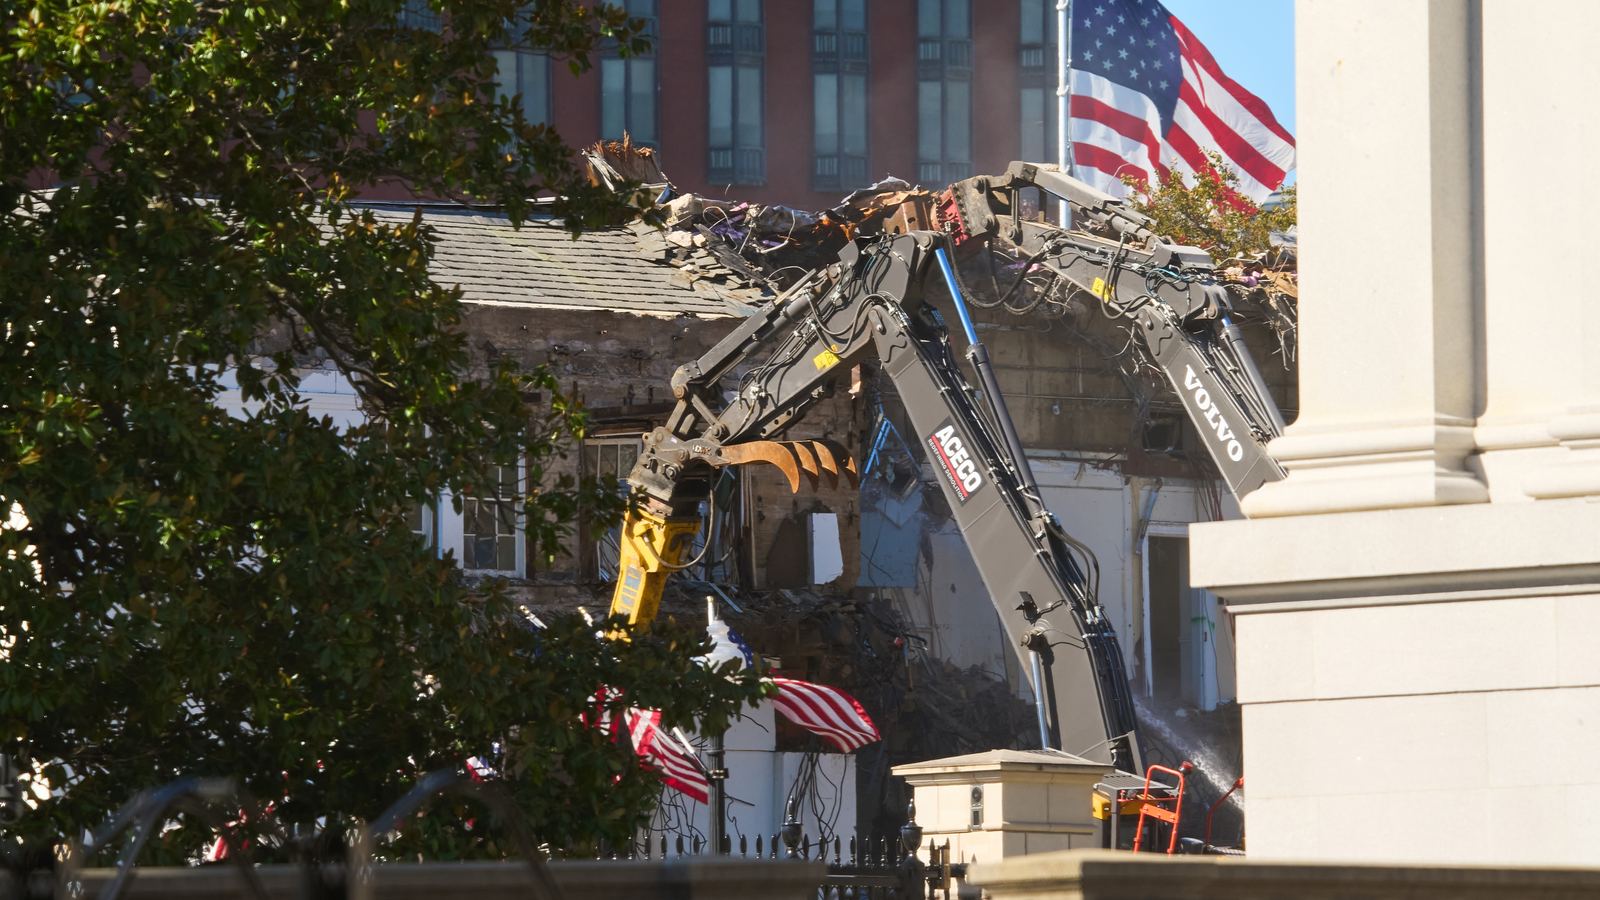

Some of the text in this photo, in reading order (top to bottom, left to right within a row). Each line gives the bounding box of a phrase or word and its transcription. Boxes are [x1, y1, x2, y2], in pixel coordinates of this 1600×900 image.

[1184, 364, 1243, 462] VOLVO
[927, 438, 965, 502] REDEFINING DEMOLITION
[935, 425, 982, 493] ACECO
